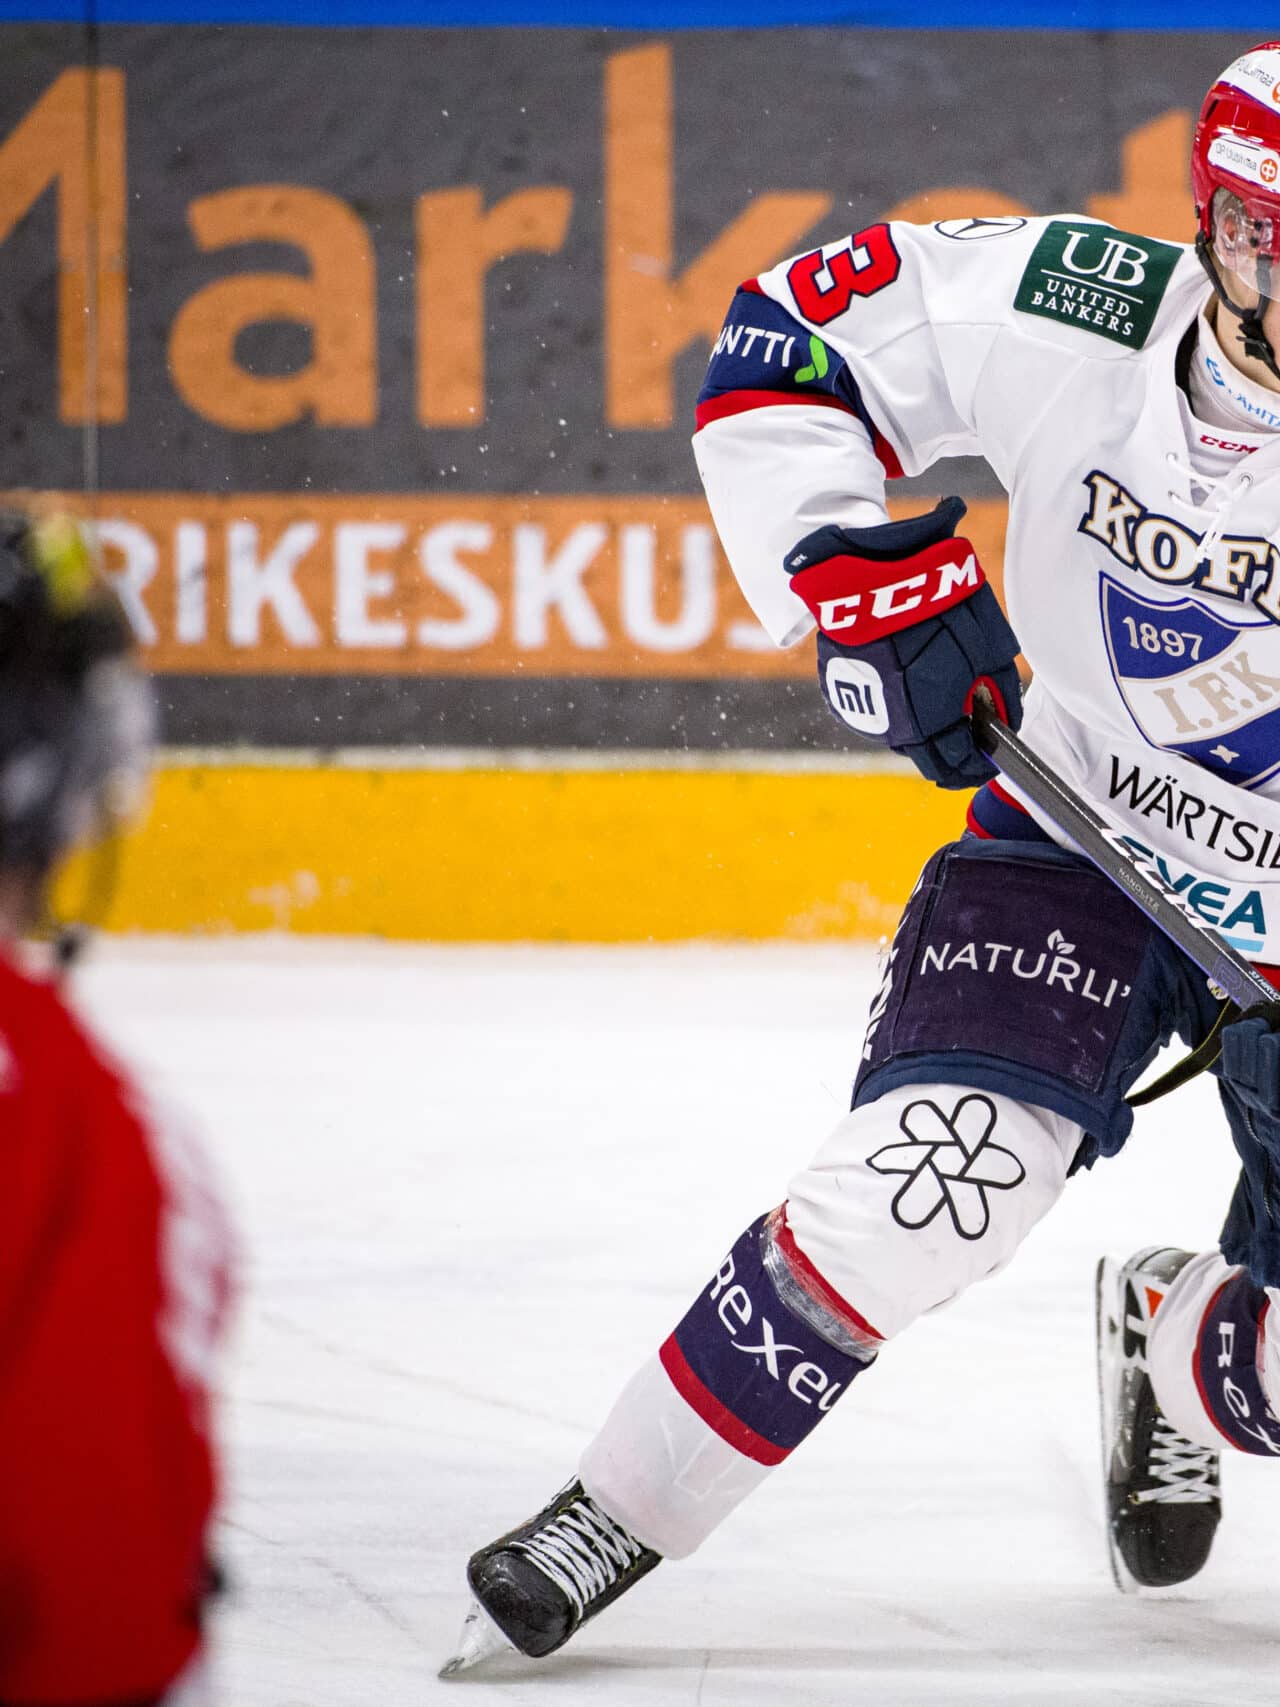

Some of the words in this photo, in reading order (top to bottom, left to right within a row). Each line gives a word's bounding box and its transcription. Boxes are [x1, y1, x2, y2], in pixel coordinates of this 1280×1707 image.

[786, 223, 902, 327] 3
[1061, 230, 1149, 287] UB
[1031, 291, 1134, 336] BANKERS
[1046, 279, 1130, 317] UNITED
[1200, 434, 1260, 455] CCM
[80, 518, 785, 652] RIKESKU
[816, 553, 978, 632] CCM
[1122, 616, 1204, 661] 1897
